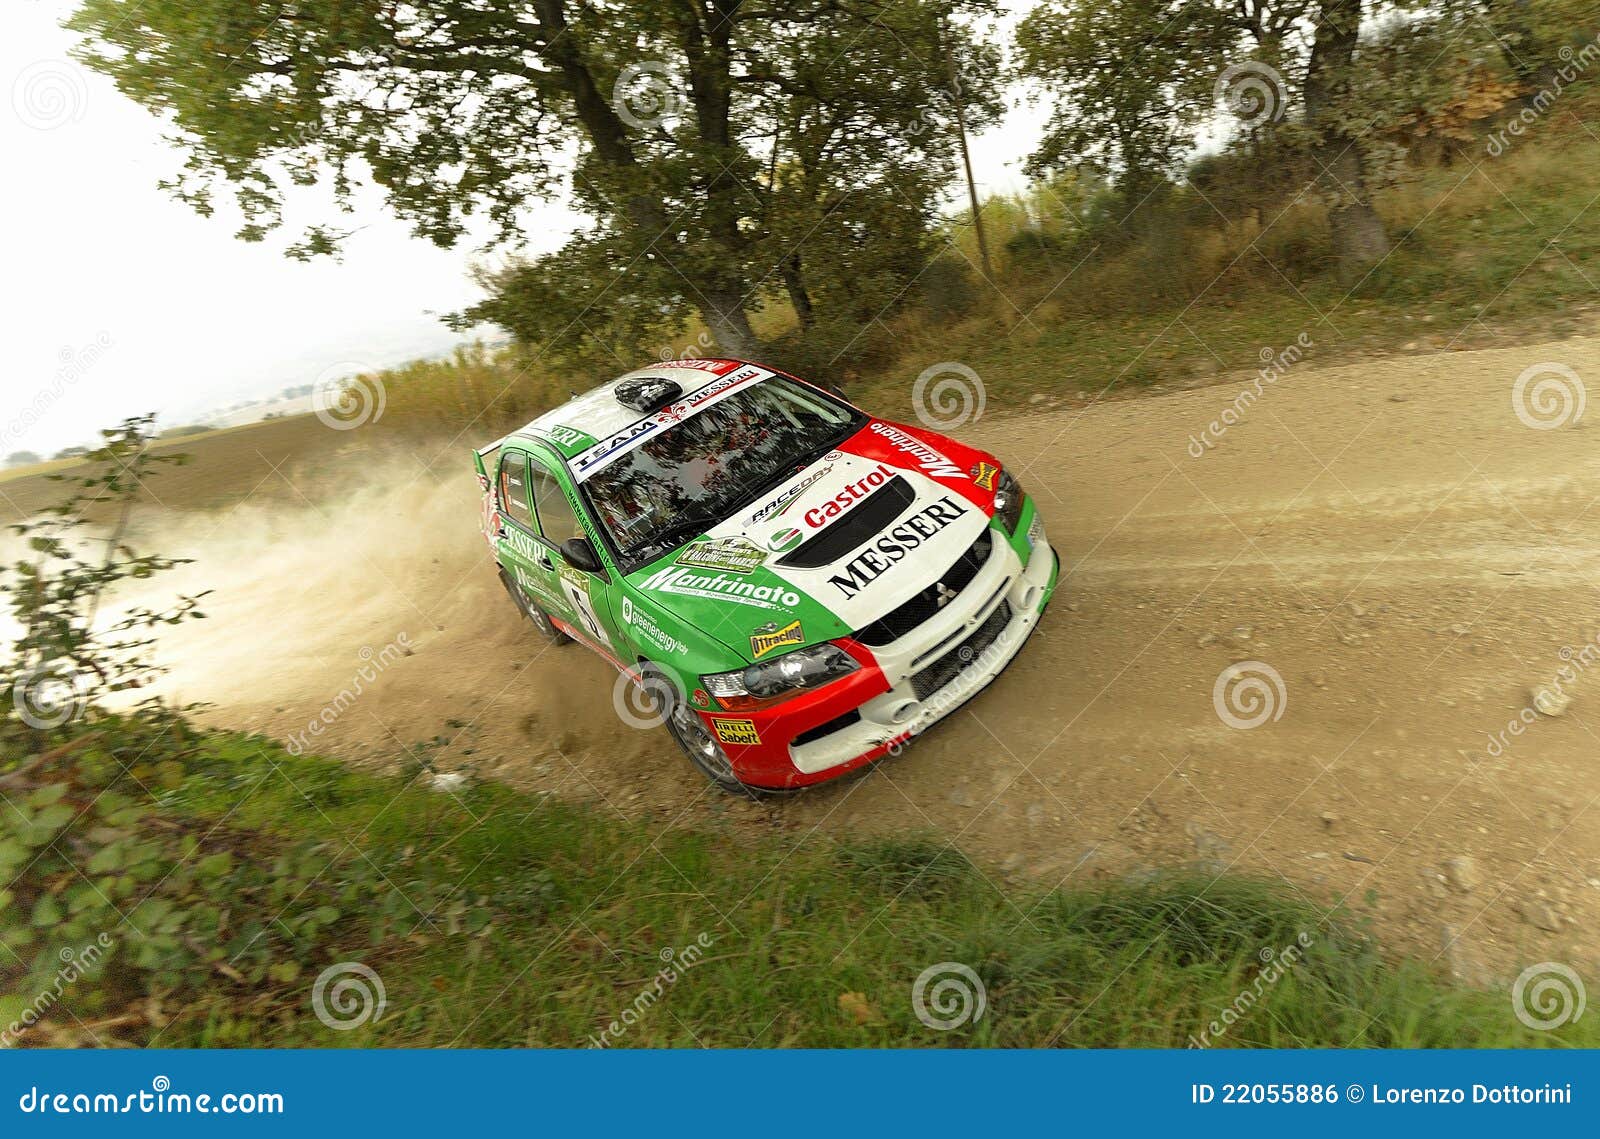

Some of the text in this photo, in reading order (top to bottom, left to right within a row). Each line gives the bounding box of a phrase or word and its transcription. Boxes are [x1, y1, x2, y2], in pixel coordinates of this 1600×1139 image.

[574, 369, 756, 467] TEAM MESSERI
[870, 423, 970, 478] Manfrinato
[752, 463, 834, 522] RACEDAY
[804, 464, 897, 528] Castrol
[827, 495, 968, 600] MESSERI
[637, 566, 800, 607] Manfrinato
